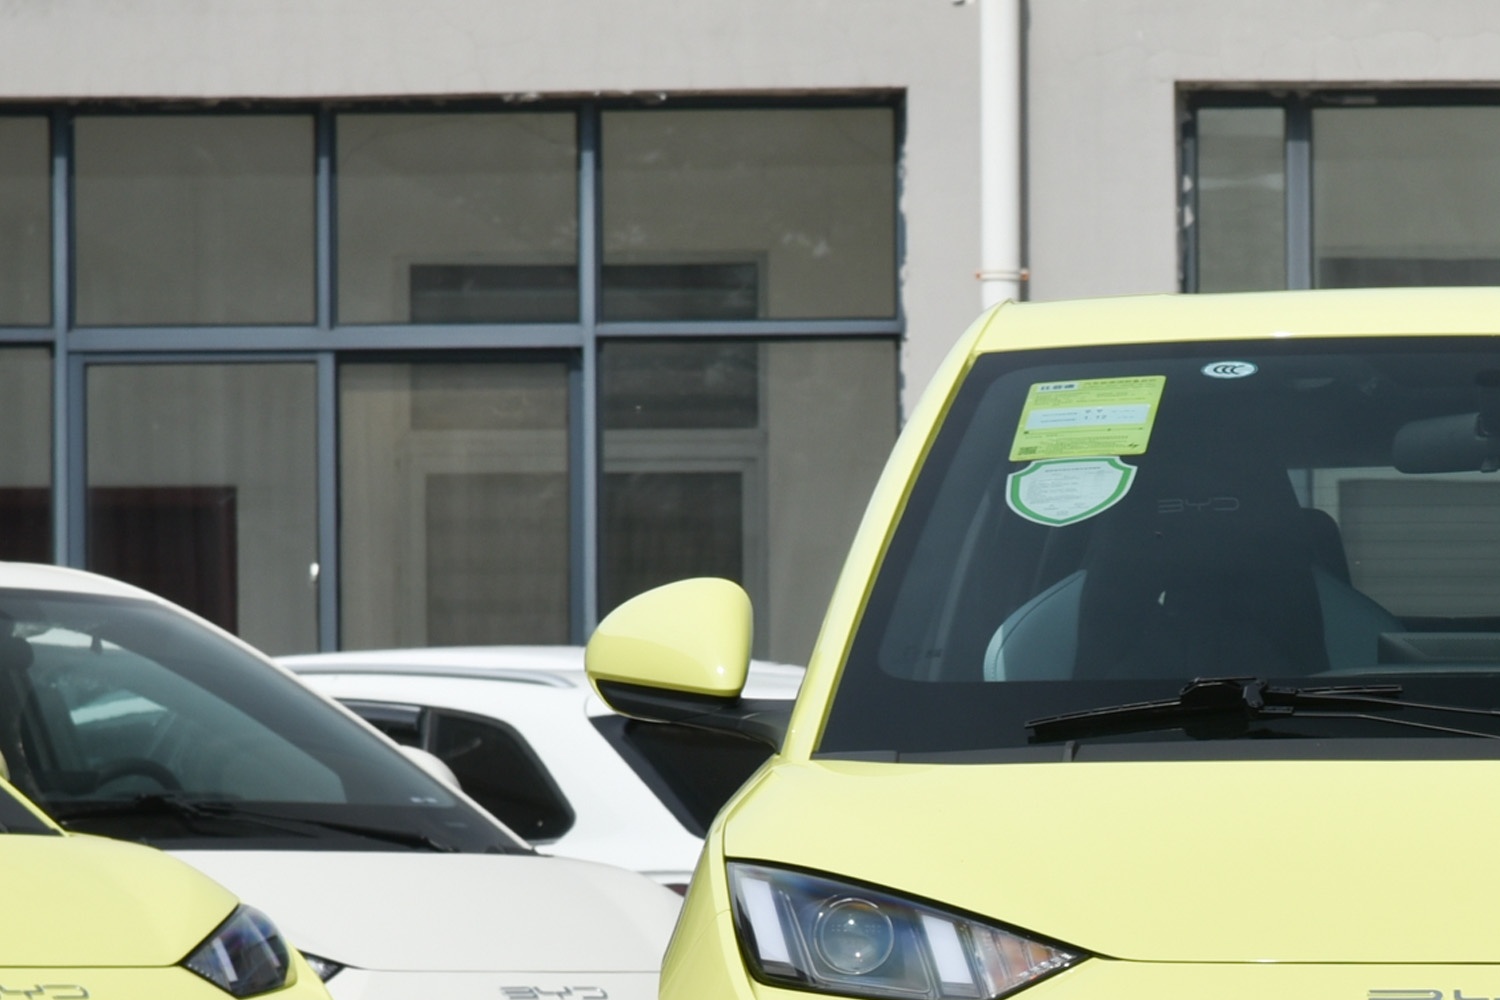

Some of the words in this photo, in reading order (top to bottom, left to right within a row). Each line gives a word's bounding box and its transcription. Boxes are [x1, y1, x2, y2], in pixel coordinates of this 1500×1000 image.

[1158, 497, 1239, 513] BYD
[0, 984, 89, 1000] YD
[500, 986, 608, 1000] BYD
